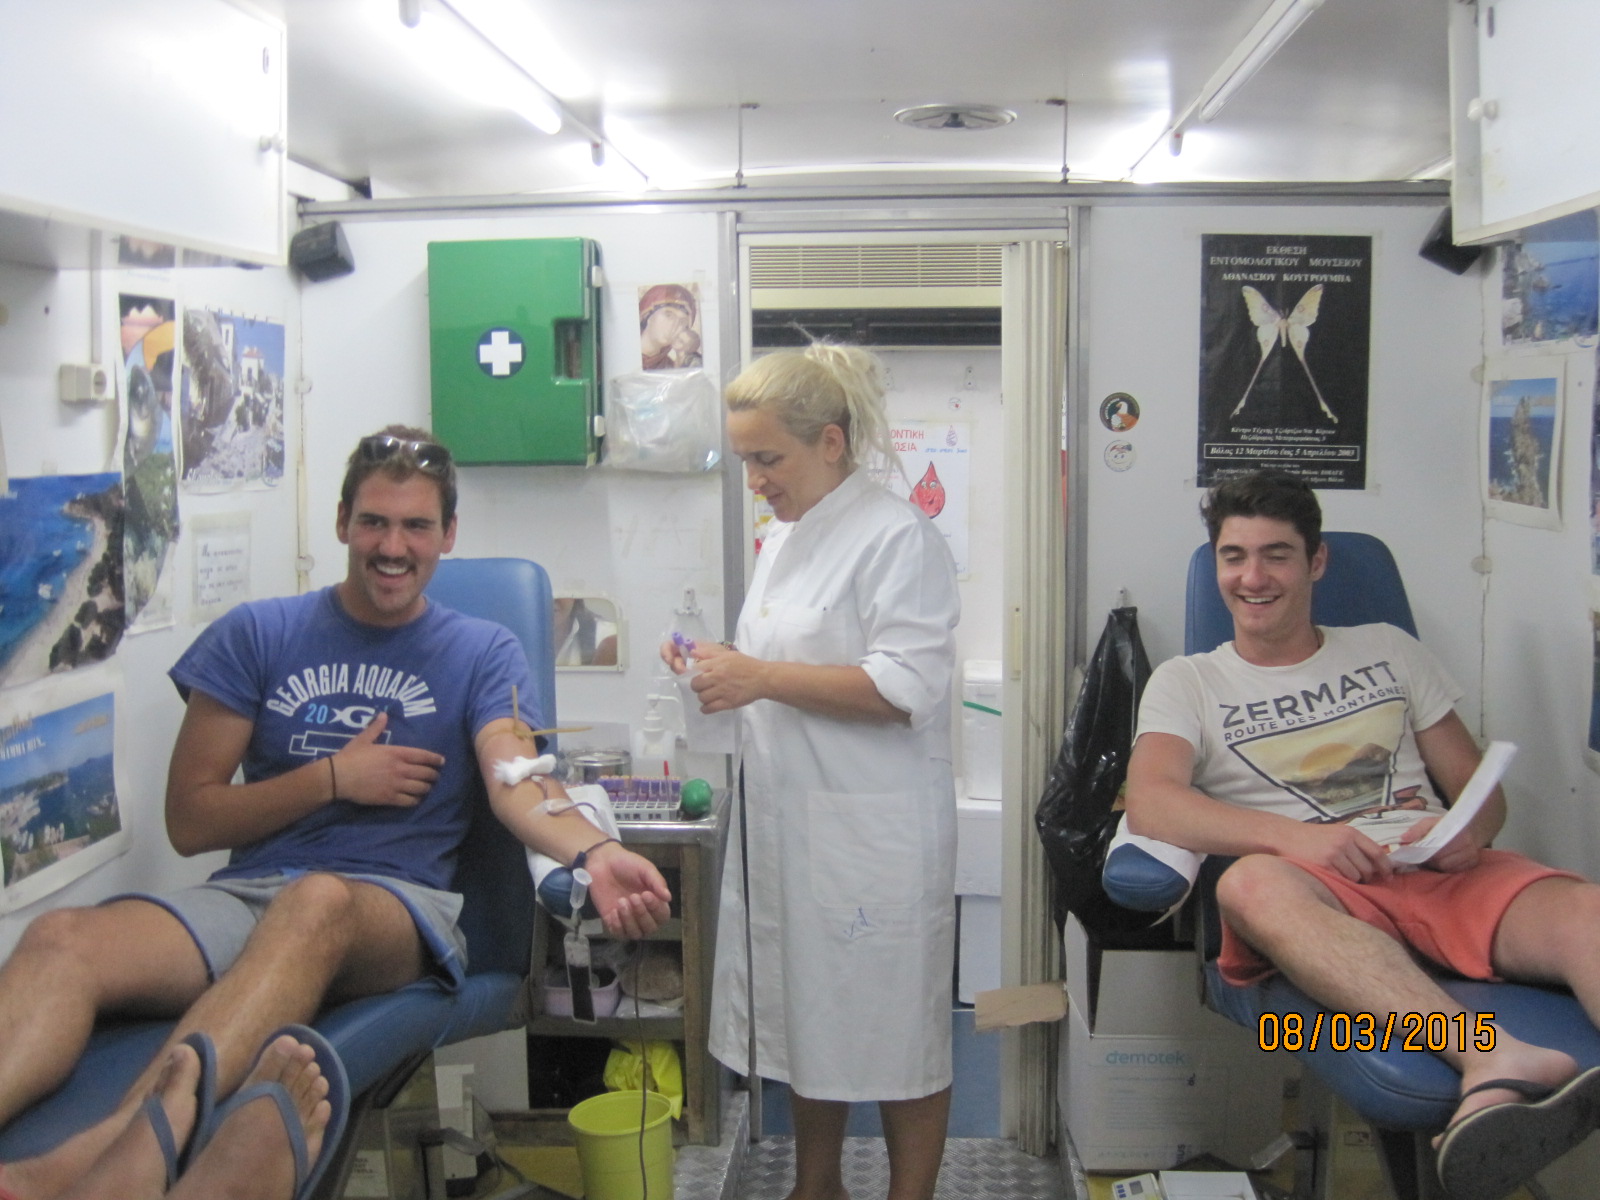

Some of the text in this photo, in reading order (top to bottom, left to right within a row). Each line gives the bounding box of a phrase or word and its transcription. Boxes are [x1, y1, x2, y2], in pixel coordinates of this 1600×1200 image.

[1265, 246, 1307, 255] ΕΚΘΕΣΗ
[1210, 256, 1363, 268] ΕΝΤΟΜΟΛΟΓΙΚΟΥ ΜΟΥΣΕΙΟΥ
[1221, 272, 1277, 282] ΑΘΑΝΑΣΙΟΥ
[266, 663, 437, 718] GEORGIA AQUARUM
[1219, 660, 1398, 729] ZERMATT
[1224, 720, 1279, 742] ROUTE
[1286, 713, 1317, 726] DES
[1105, 1050, 1186, 1066] demotek
